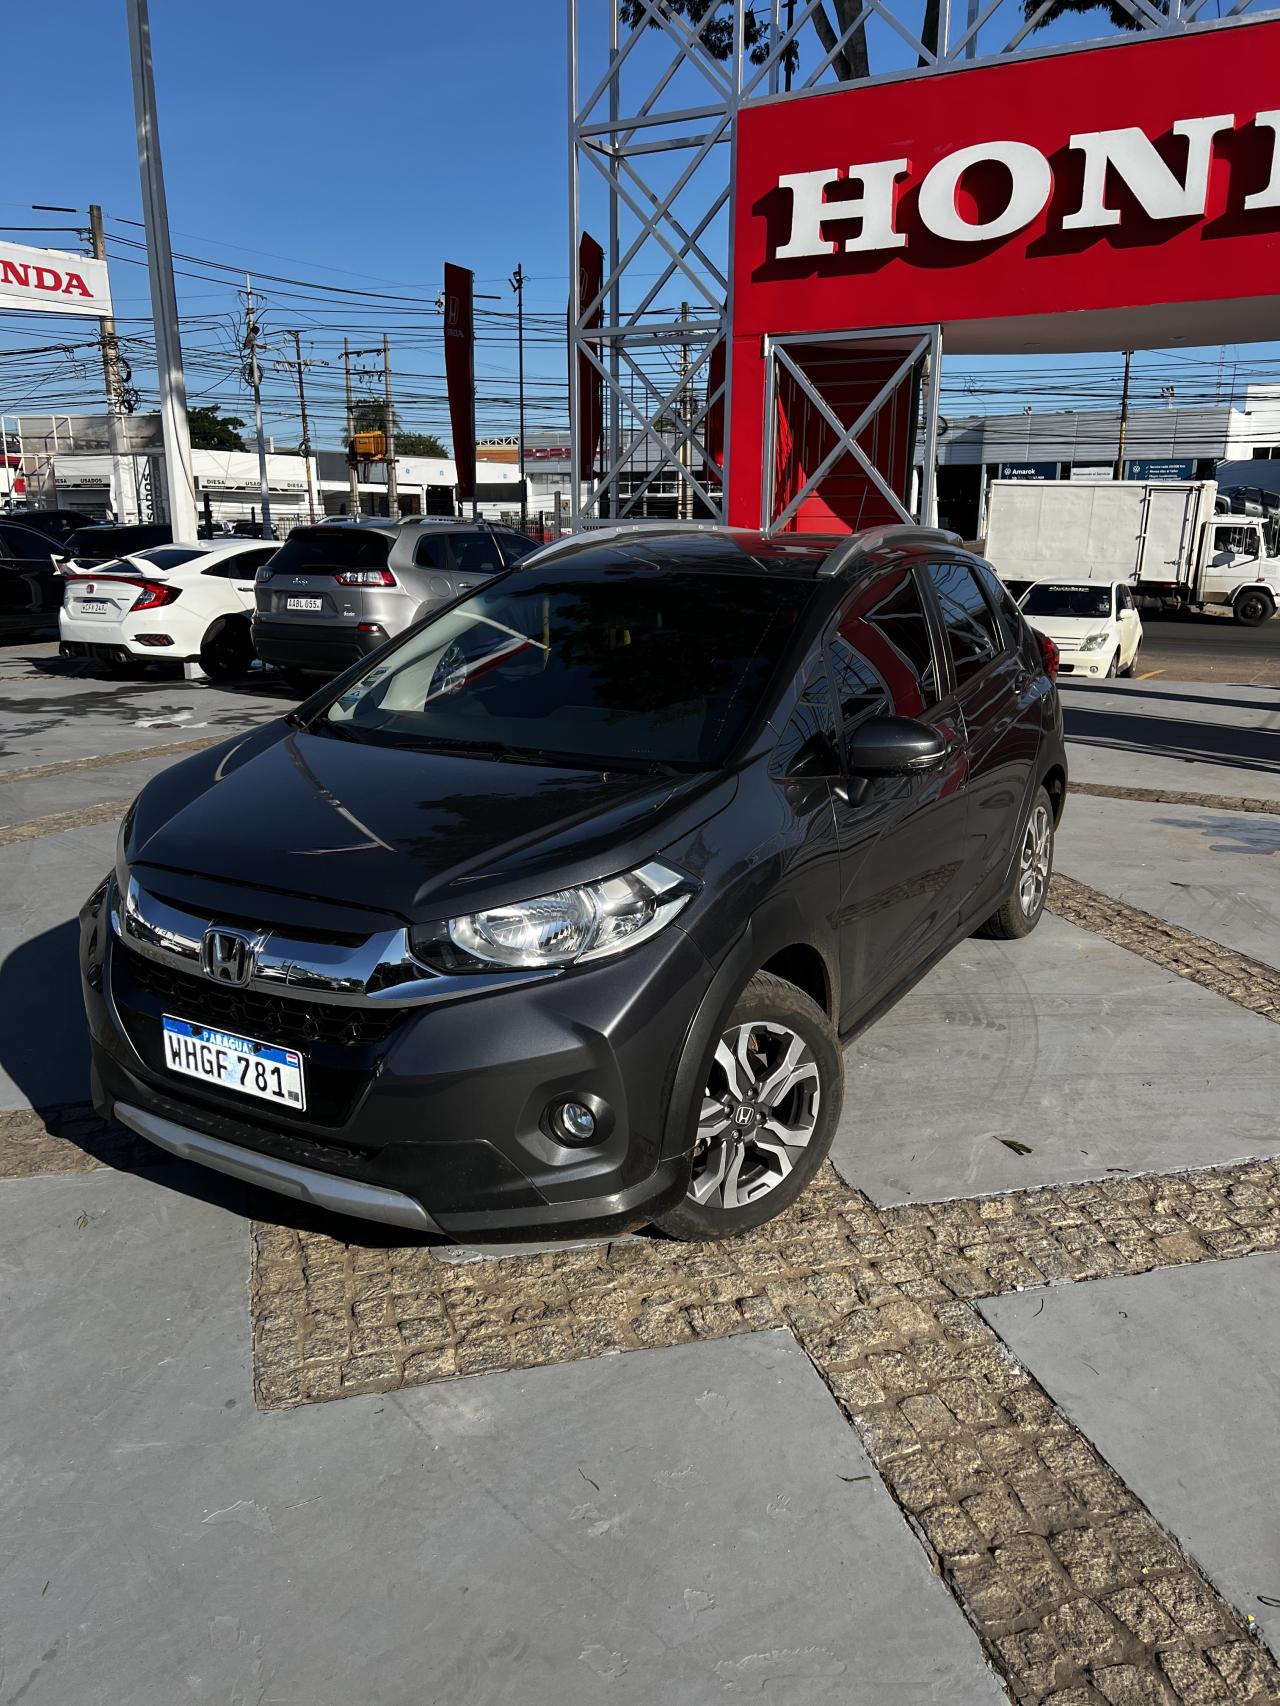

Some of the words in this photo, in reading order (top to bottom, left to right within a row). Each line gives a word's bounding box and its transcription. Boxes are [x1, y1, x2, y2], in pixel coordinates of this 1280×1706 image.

[775, 110, 1280, 259] HON
[168, 1035, 228, 1080] WHGF
[237, 1056, 285, 1098] 781
